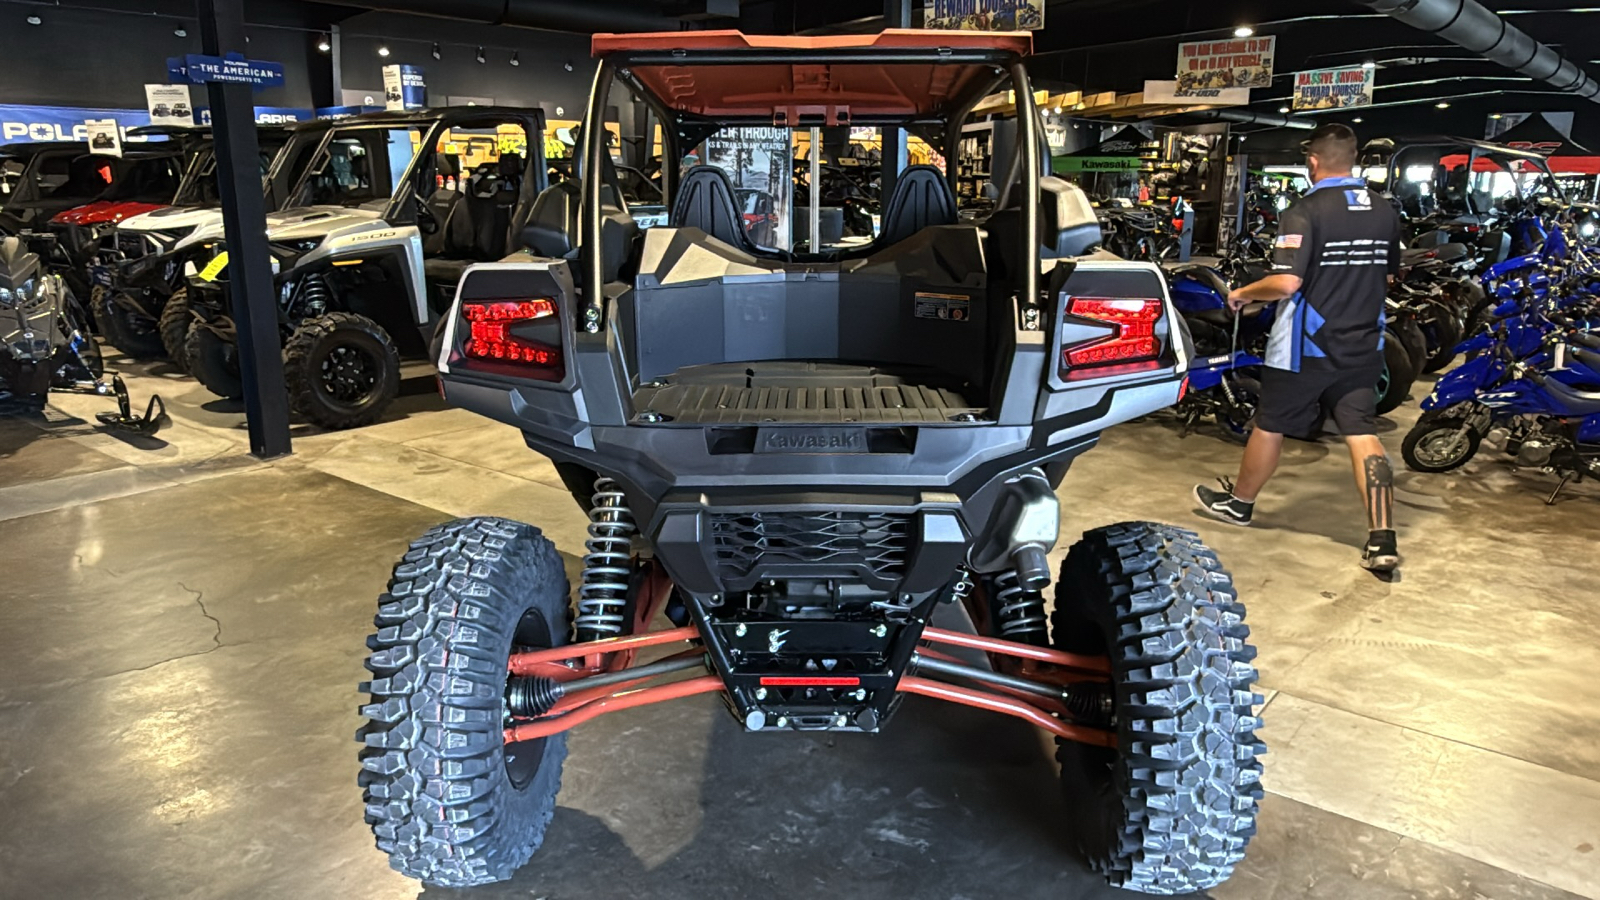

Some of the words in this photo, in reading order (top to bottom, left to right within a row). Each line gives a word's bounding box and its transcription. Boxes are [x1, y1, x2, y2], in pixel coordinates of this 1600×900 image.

[1212, 41, 1246, 55] WELCOME
[1248, 40, 1257, 52] TO
[1259, 38, 1271, 52] SIT
[1233, 53, 1262, 67] VEHICLE
[200, 63, 220, 73] THE
[223, 66, 274, 78] AMERICAN
[1302, 86, 1330, 98] REWARD
[1332, 83, 1364, 97] YOURSELF
[255, 113, 298, 124] ARIS
[2, 122, 148, 142] POLAIS
[740, 127, 789, 140] THROUGH
[722, 142, 741, 150] TRAILS
[1081, 160, 1130, 169] Kawasaki
[352, 231, 396, 241] 1500
[765, 432, 862, 448] Kawasaki
